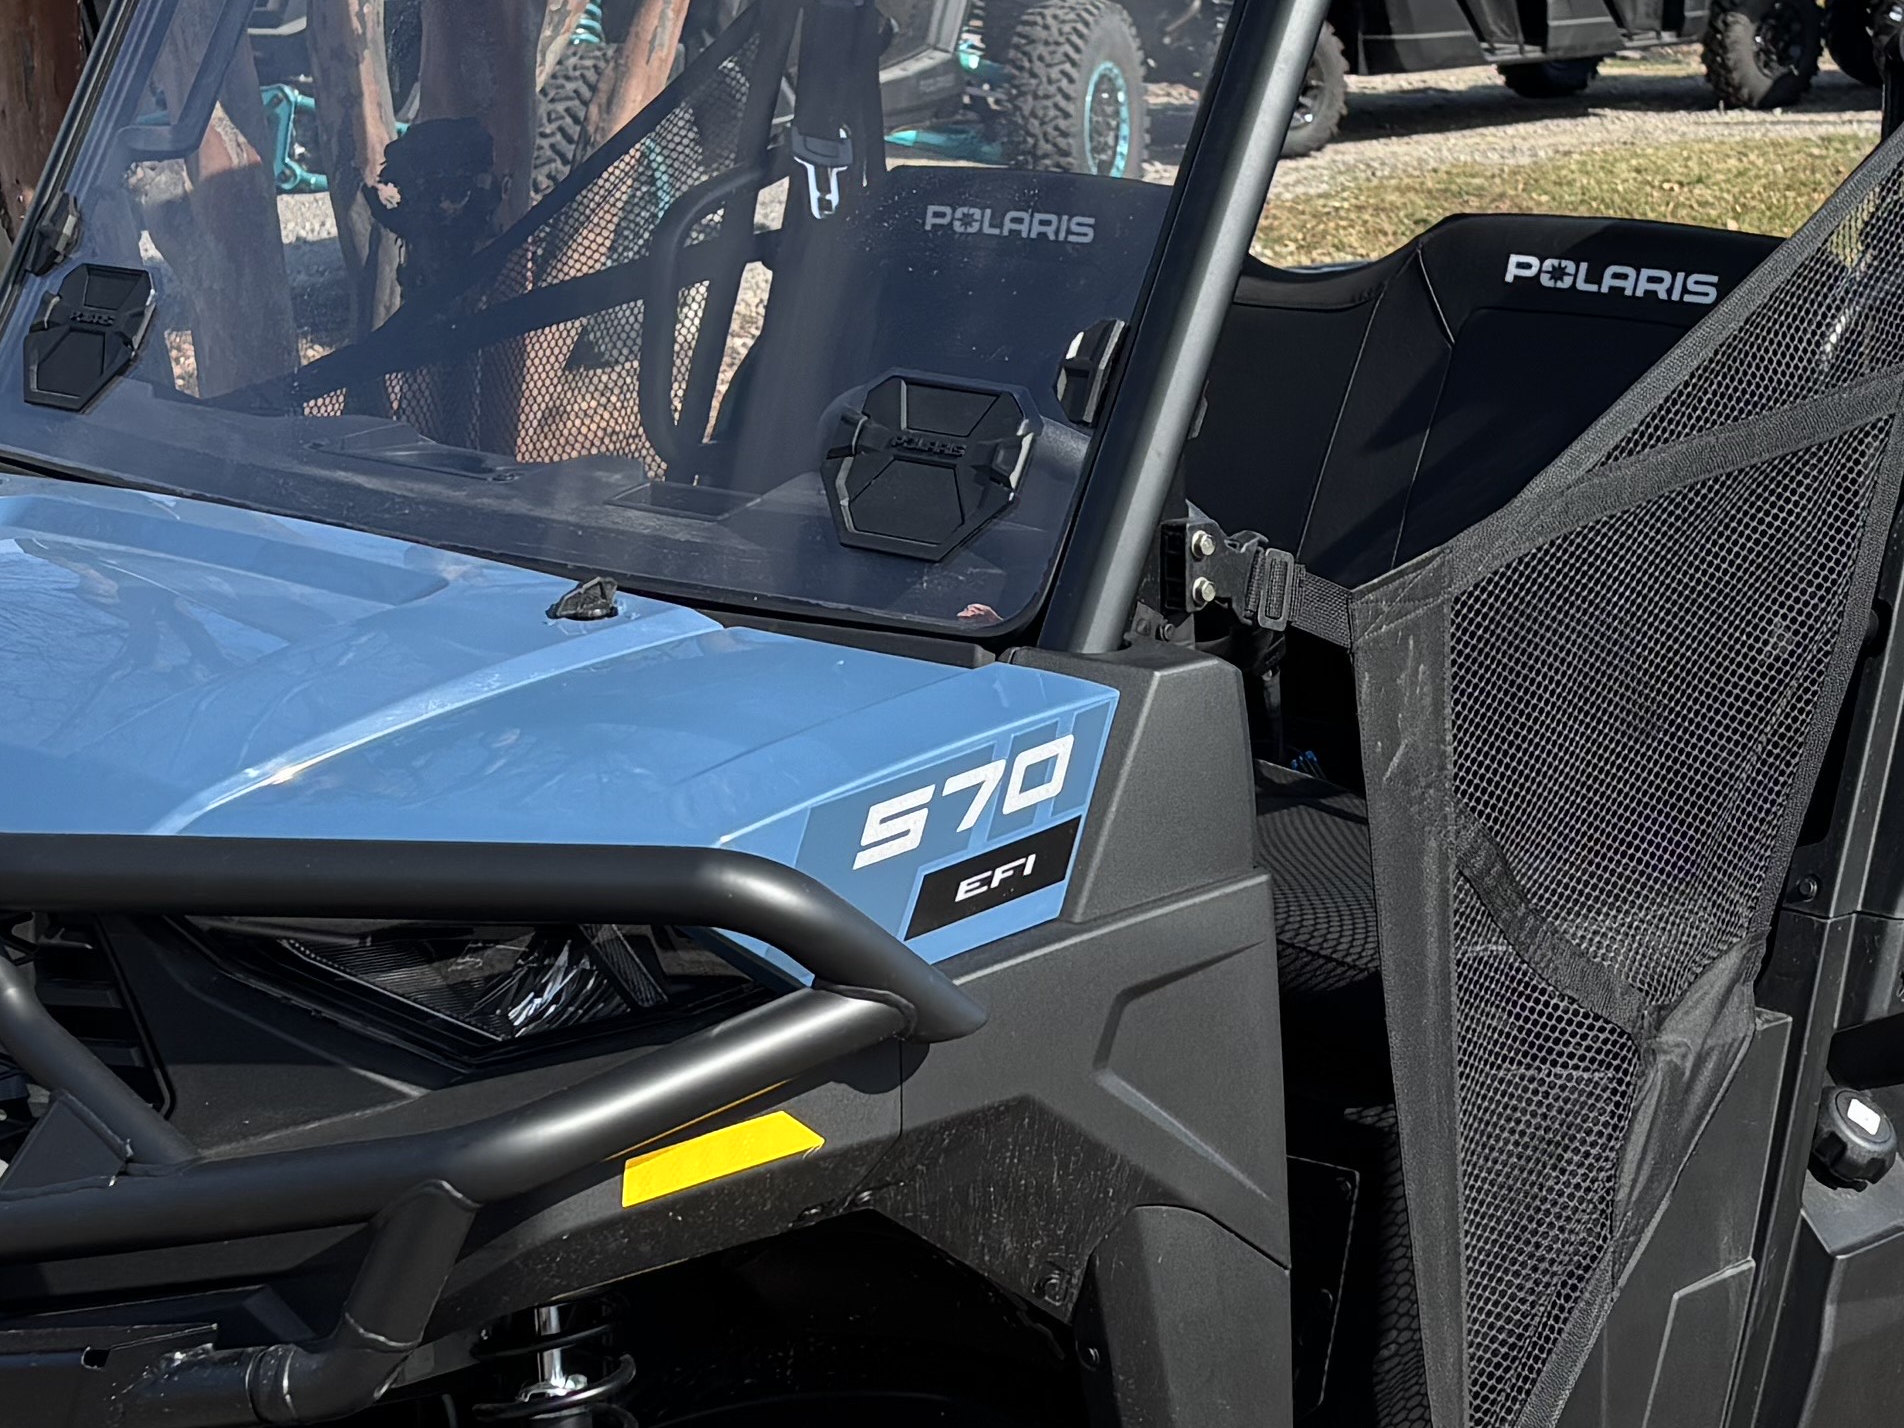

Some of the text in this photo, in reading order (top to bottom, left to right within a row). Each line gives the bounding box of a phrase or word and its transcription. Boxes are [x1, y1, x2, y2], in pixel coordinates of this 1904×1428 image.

[924, 205, 1095, 243] POLARIS
[1504, 253, 1719, 305] POLARIS
[852, 734, 1075, 870] 570
[954, 853, 1036, 903] EFI
